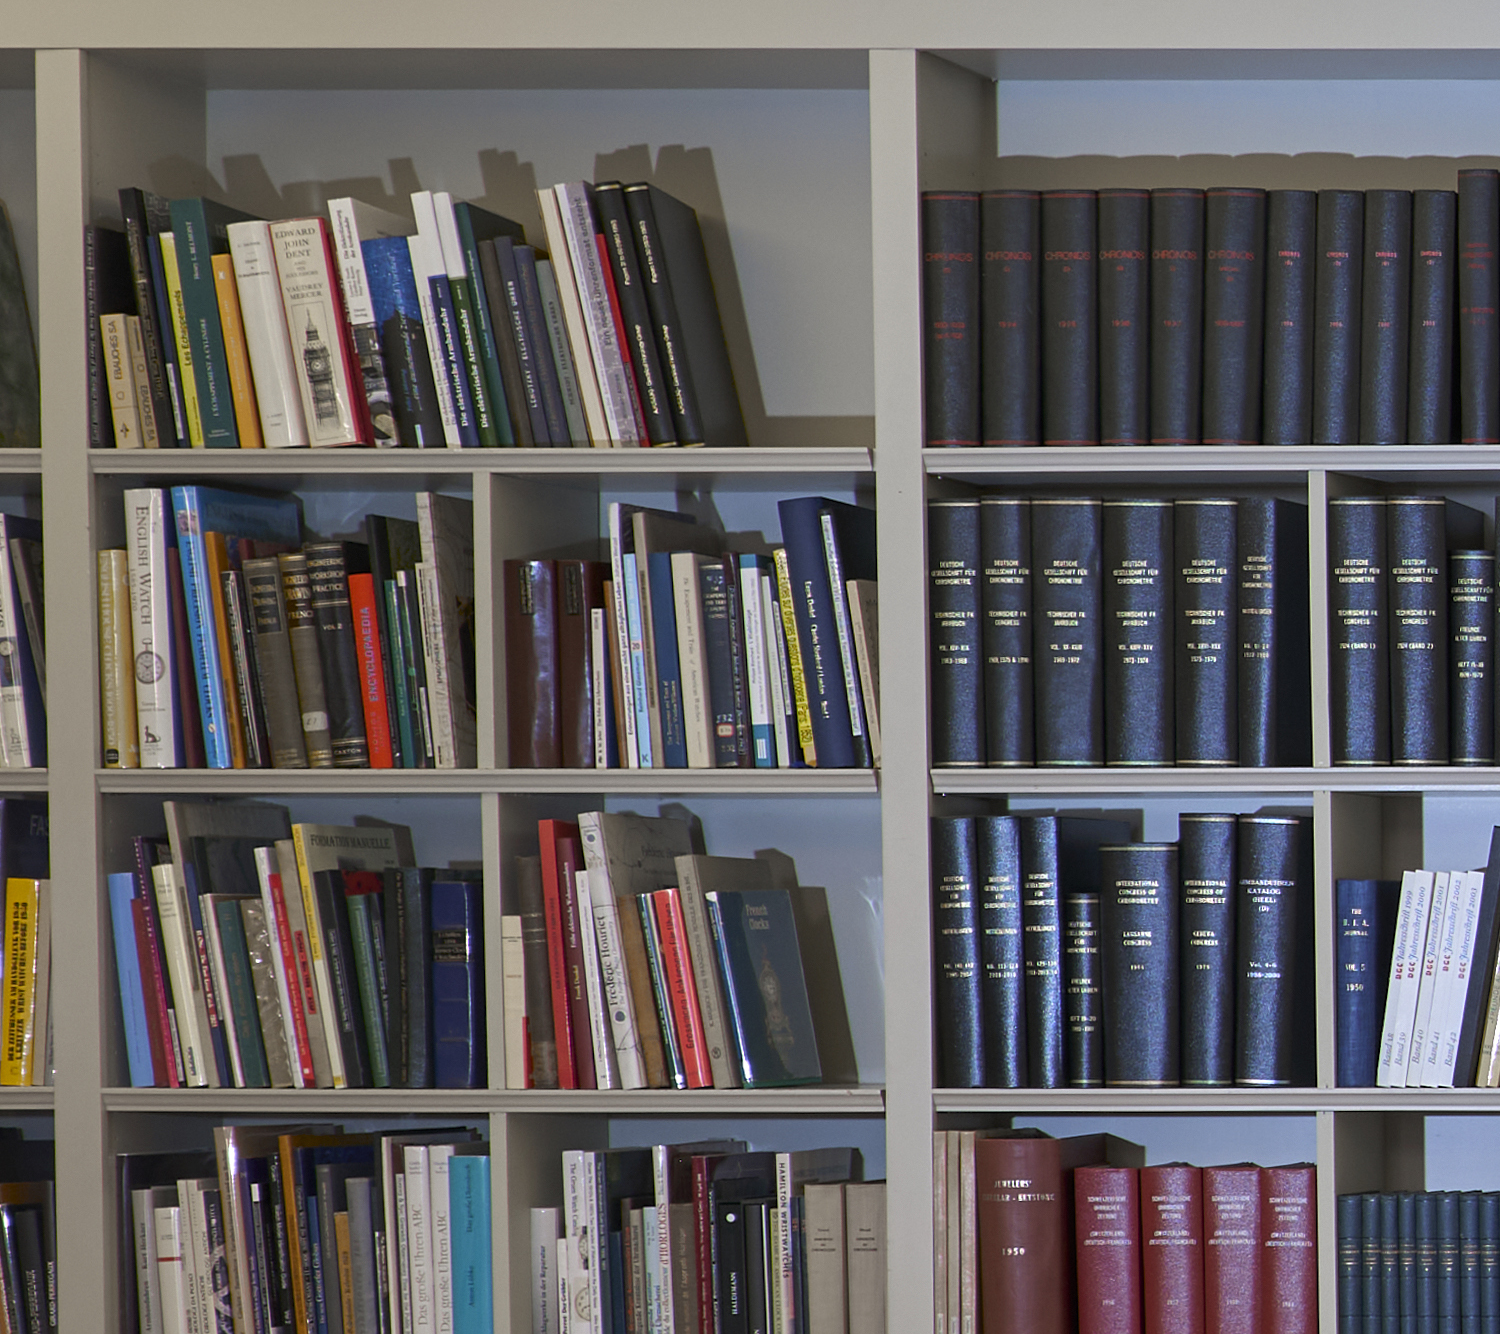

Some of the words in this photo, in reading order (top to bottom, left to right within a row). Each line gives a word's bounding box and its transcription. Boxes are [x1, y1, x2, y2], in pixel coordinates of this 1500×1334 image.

[573, 196, 589, 238] entsteht
[275, 228, 315, 239] EDWARD
[284, 240, 309, 249] JOHN
[285, 249, 311, 259] DENT
[581, 238, 602, 300] Uhrenformat
[286, 283, 323, 293] VAUDREY
[290, 291, 322, 300] MERCER
[107, 320, 117, 333] SA
[438, 305, 457, 363] Armbanduhr
[458, 307, 477, 364] Armbanduhr
[601, 330, 612, 347] Ein
[108, 334, 123, 380] EBAUCHES
[449, 361, 466, 410] elektrische
[468, 362, 486, 413] elektrische
[458, 410, 469, 427] Die
[478, 411, 489, 429] Die
[135, 505, 150, 567] ENGLISH
[138, 570, 153, 625] WATCH
[614, 580, 622, 600] Leben
[686, 624, 694, 635] and
[359, 607, 378, 702] ENCYCLOPAEDIA
[687, 638, 695, 654] Train
[1402, 890, 1414, 909] 1999
[1415, 885, 1427, 907] 2000
[1433, 884, 1445, 906] 2001
[1466, 886, 1478, 908] 2003
[746, 904, 767, 916] French
[750, 918, 769, 930] Clocks
[595, 916, 610, 959] Houriet
[601, 960, 619, 1007] Frédéric
[1346, 983, 1364, 992] 1950
[1415, 1027, 1425, 1040] 40
[1431, 1030, 1441, 1040] 41
[1411, 1039, 1423, 1063] Band
[1426, 1040, 1440, 1064] Band
[777, 1161, 787, 1208] HAMILTON
[779, 1210, 790, 1279] WRISTWATCHES
[1002, 1247, 1025, 1256] 1950
[414, 1268, 429, 1303] große
[438, 1275, 451, 1309] große
[729, 1271, 738, 1315] HALDIMANN
[416, 1303, 428, 1326] Das
[439, 1309, 450, 1333] Das
